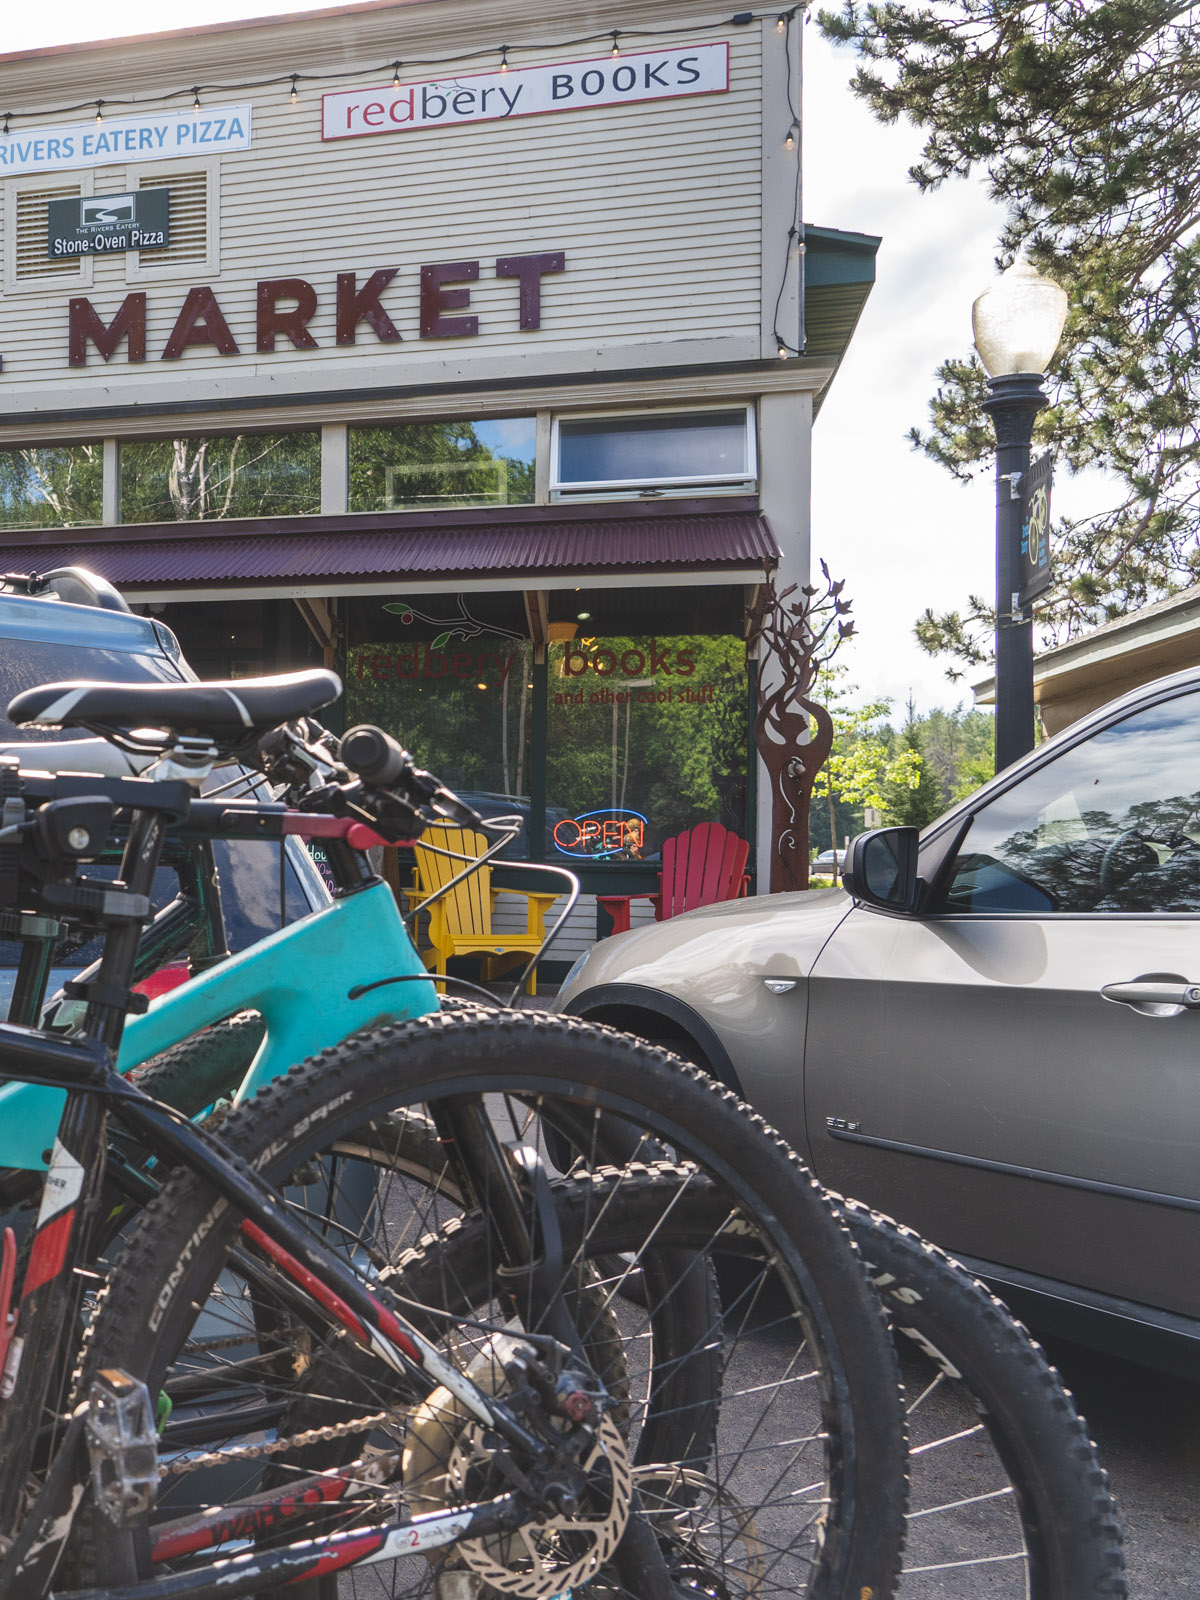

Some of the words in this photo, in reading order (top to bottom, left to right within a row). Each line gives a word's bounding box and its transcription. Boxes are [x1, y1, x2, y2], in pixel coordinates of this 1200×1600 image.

[346, 83, 524, 129] redbery
[552, 56, 701, 100] BOOKS
[82, 125, 169, 156] EATERY
[176, 117, 245, 145] PIZZA
[54, 234, 126, 254] Stone-Oven
[131, 229, 164, 247] Pizza
[76, 226, 89, 234] THE
[116, 222, 141, 231] EATERY
[68, 251, 567, 368] MARKET
[357, 643, 516, 688] redbery
[564, 640, 696, 677] books
[553, 690, 586, 705] and
[589, 687, 632, 704] other
[636, 687, 673, 704] cool
[677, 684, 717, 704] stuff
[553, 819, 644, 848] OPEN
